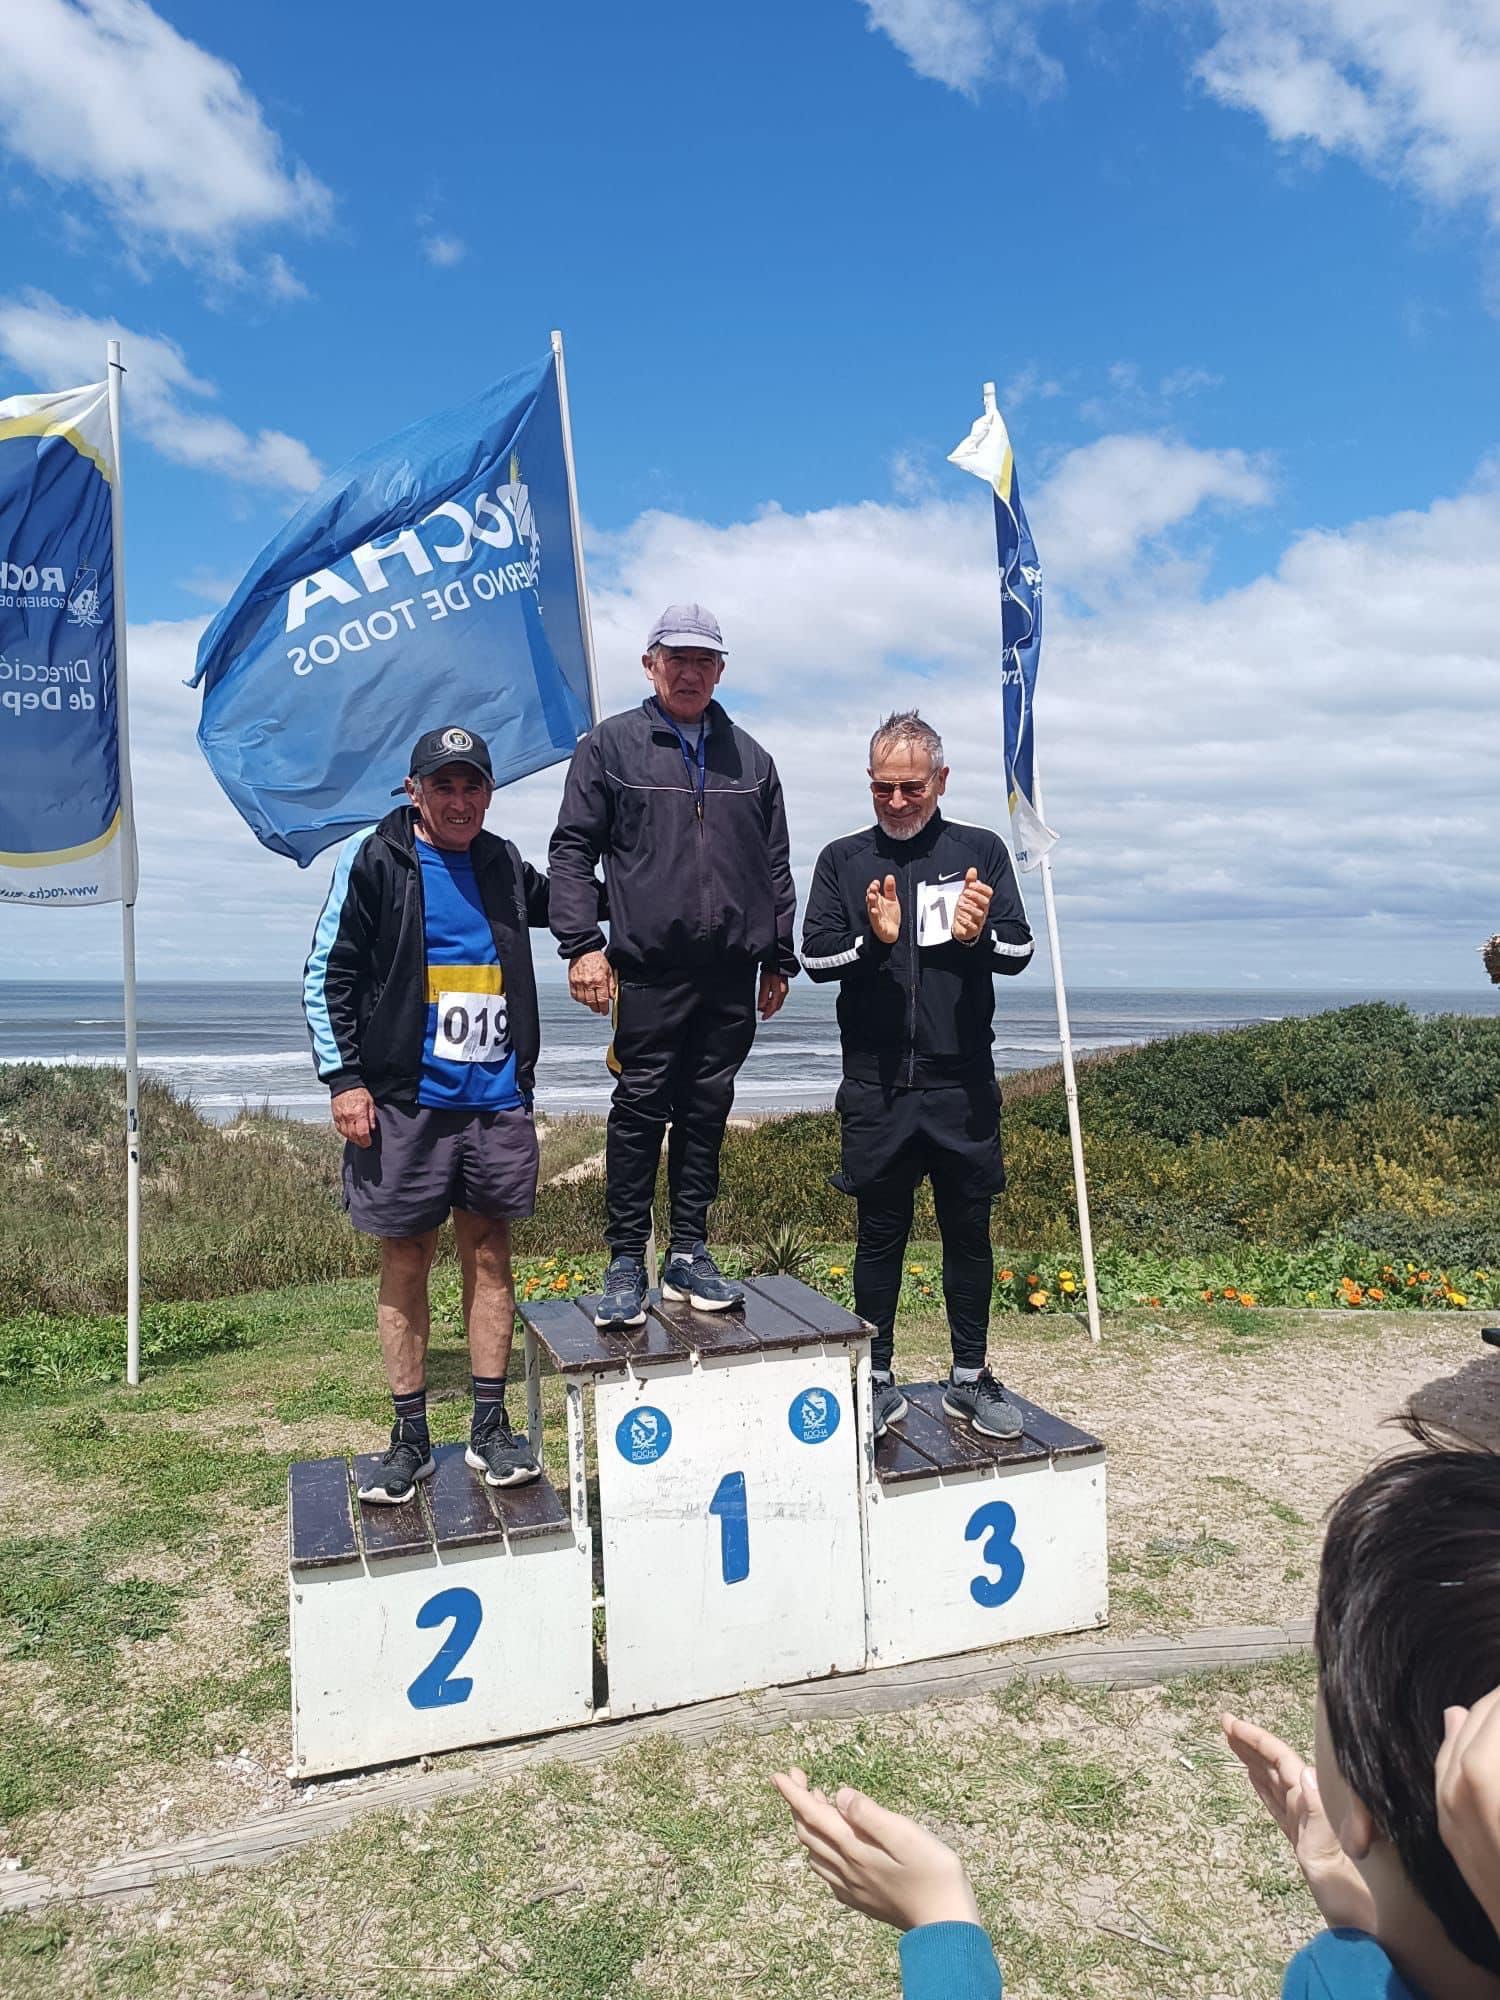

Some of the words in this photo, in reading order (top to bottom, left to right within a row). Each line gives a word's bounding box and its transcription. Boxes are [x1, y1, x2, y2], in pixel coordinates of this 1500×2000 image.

[443, 1005, 510, 1047] 019
[709, 1471, 750, 1585] 1
[964, 1501, 1025, 1608] 3
[407, 1587, 483, 1709] 2
